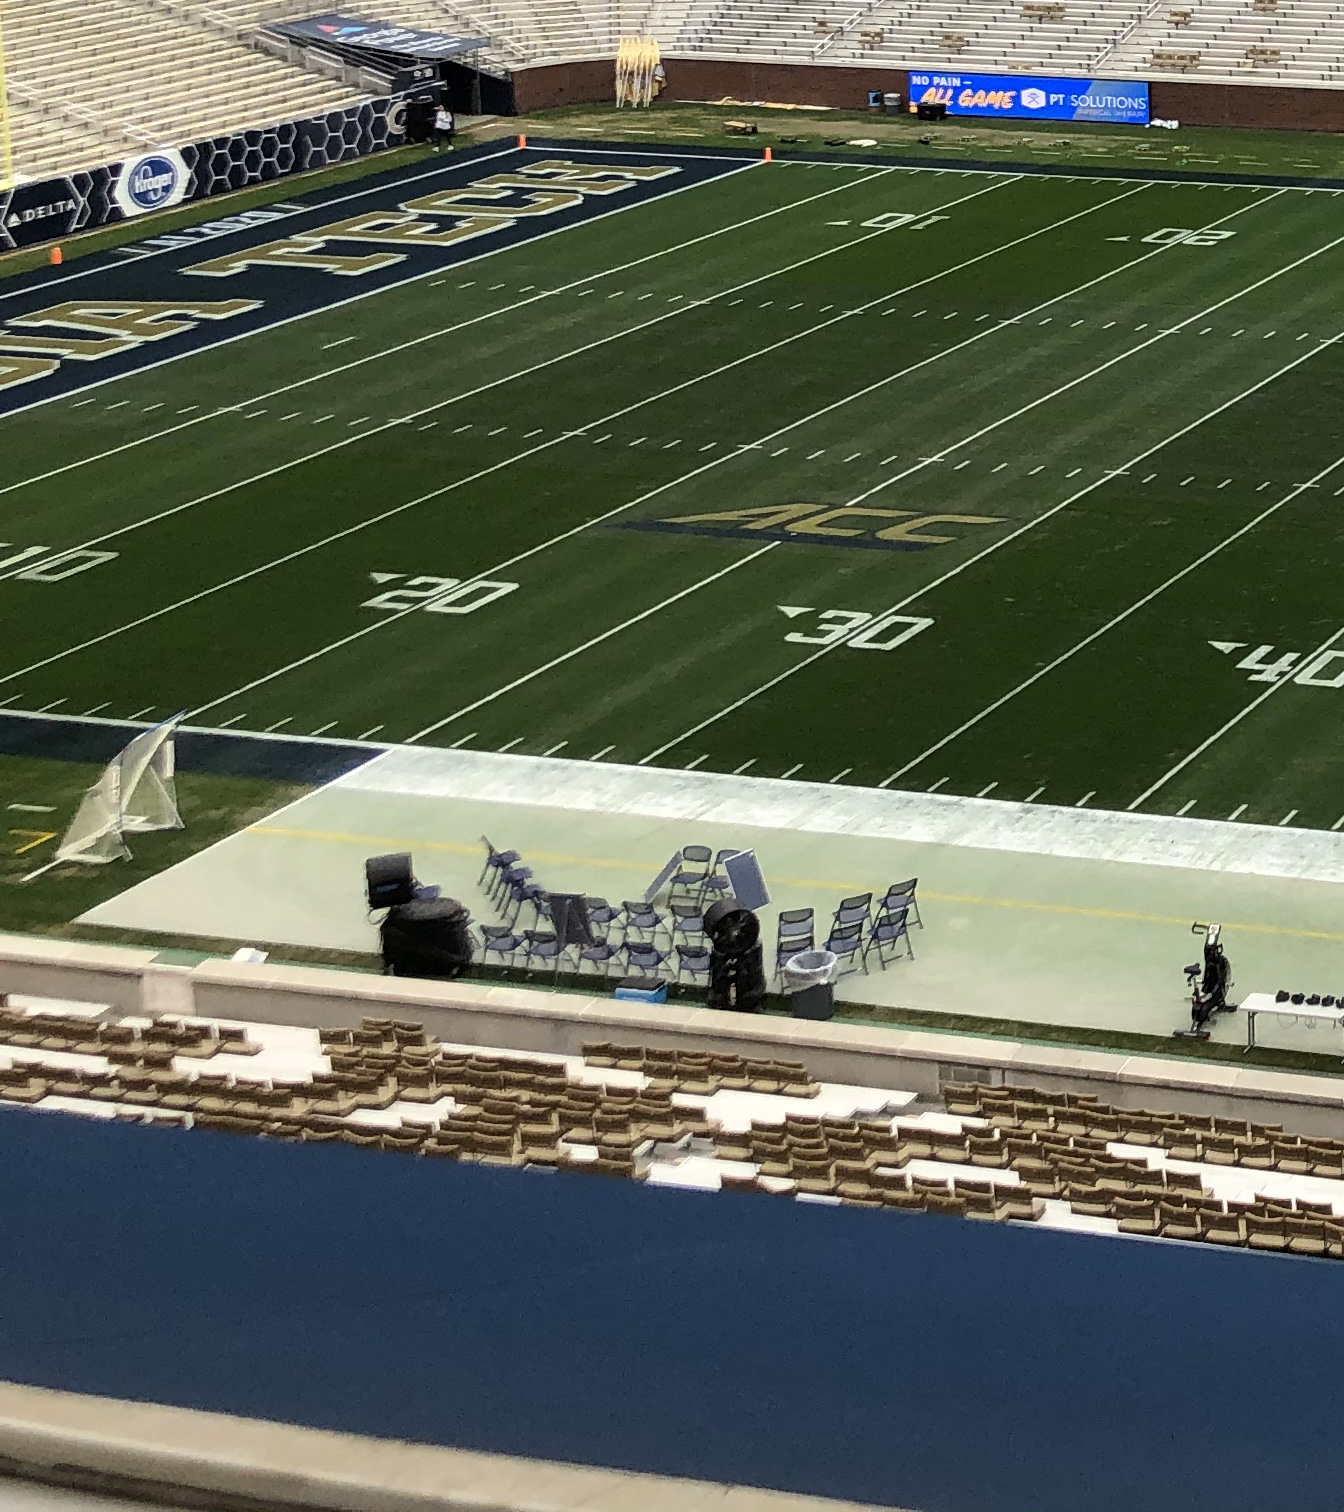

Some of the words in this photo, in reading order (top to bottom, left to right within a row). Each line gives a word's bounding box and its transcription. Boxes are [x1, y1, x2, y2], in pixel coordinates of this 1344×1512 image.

[911, 75, 928, 86] NO
[933, 76, 961, 87] PAIN
[920, 87, 954, 106] ALL
[957, 89, 1018, 110] GAME
[1049, 94, 1065, 106] PT
[1070, 94, 1147, 109] SOLUTIONS
[135, 165, 174, 201] Kroger
[22, 199, 76, 223] DELTA
[179, 160, 684, 277] TECH
[652, 502, 1007, 544] ACC
[361, 575, 519, 614] 20
[786, 609, 934, 651] 30
